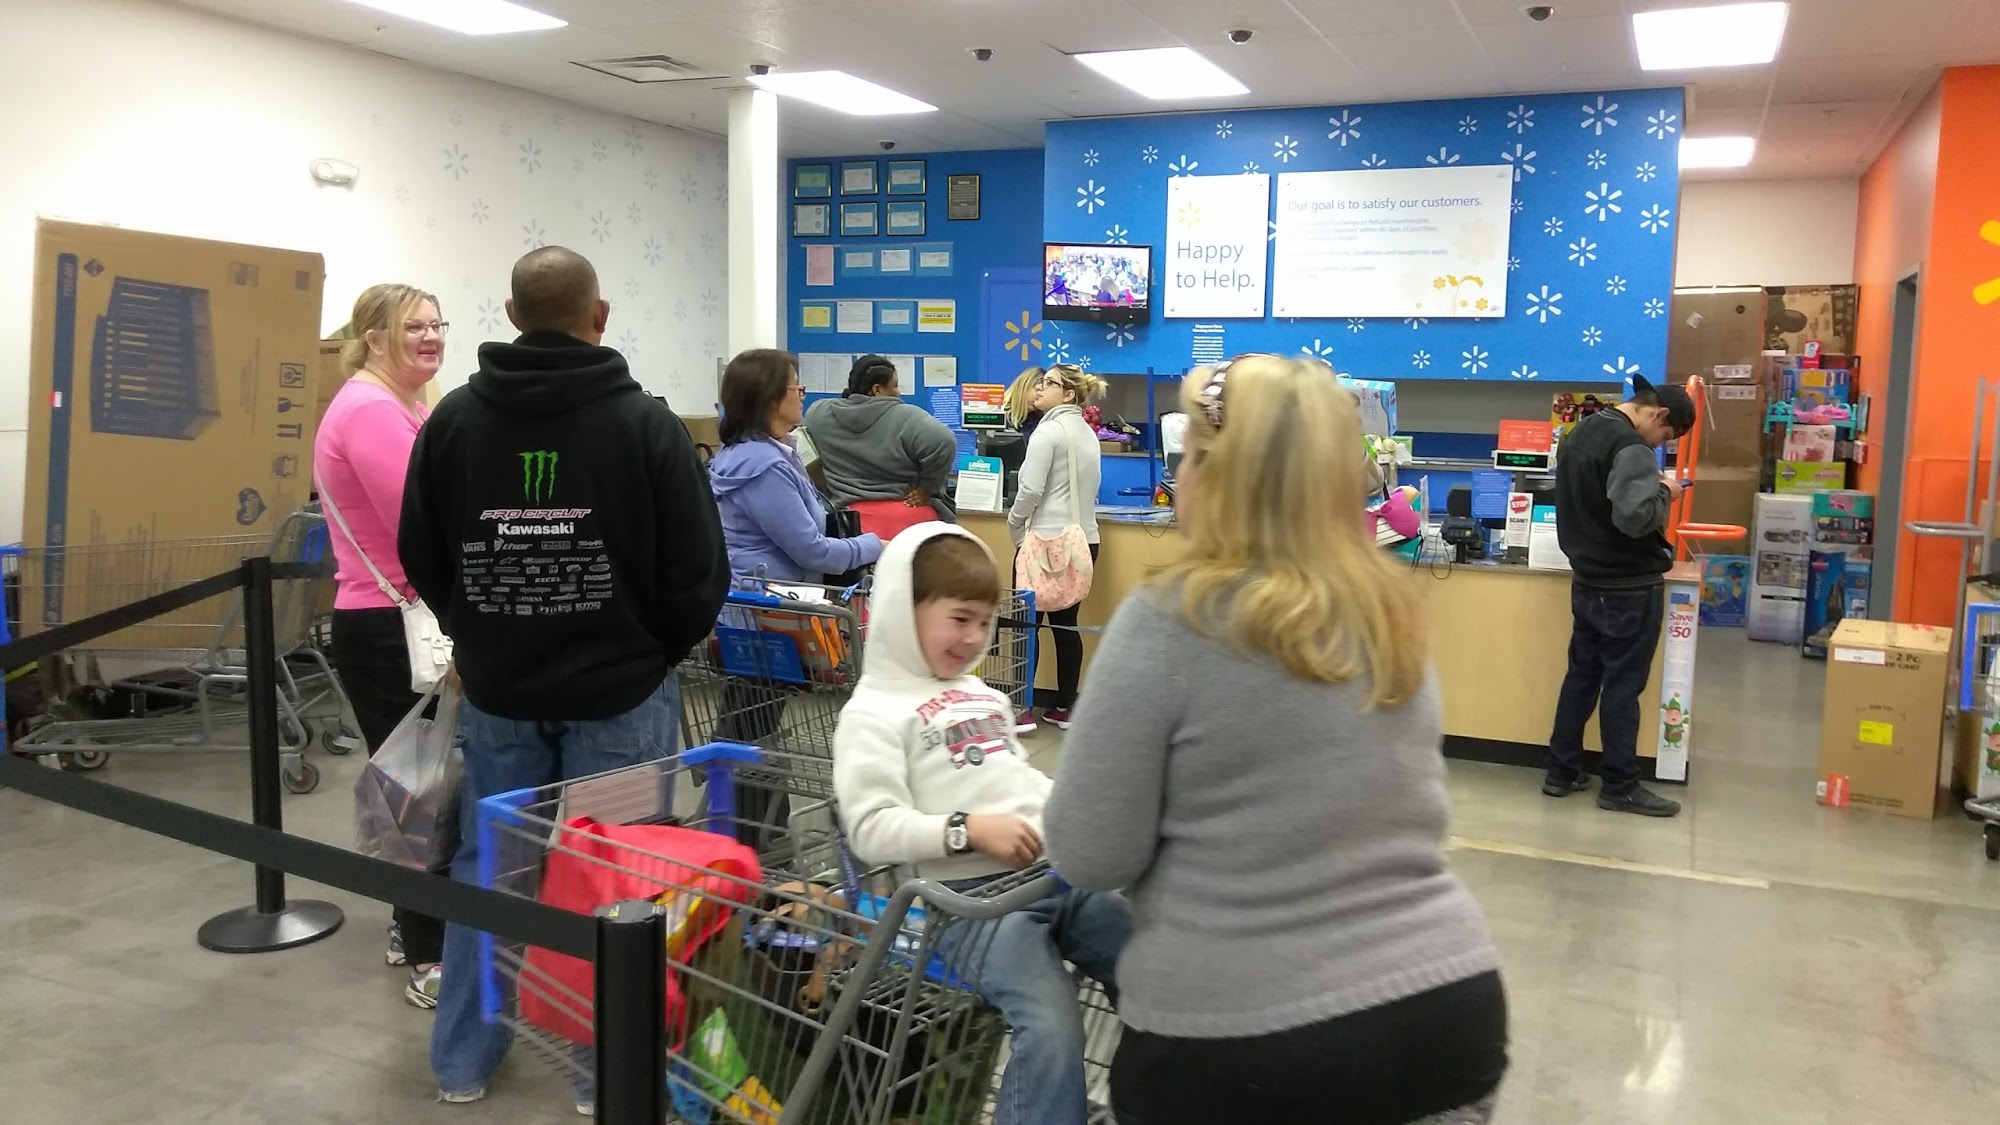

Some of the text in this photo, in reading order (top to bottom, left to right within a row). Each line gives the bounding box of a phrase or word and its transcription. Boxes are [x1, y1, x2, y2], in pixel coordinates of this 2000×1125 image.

[1288, 197, 1482, 213] Our goal is to satisfy our customers.
[1177, 241, 1244, 263] Happy
[1176, 269, 1255, 292] to Help.
[1511, 500, 1529, 509] STOP
[479, 508, 592, 520] PRO CIRCUIT
[497, 521, 575, 535] Kawasaki
[462, 541, 487, 552] VANS
[1669, 611, 1694, 621] Save
[1668, 625, 1692, 639] $50
